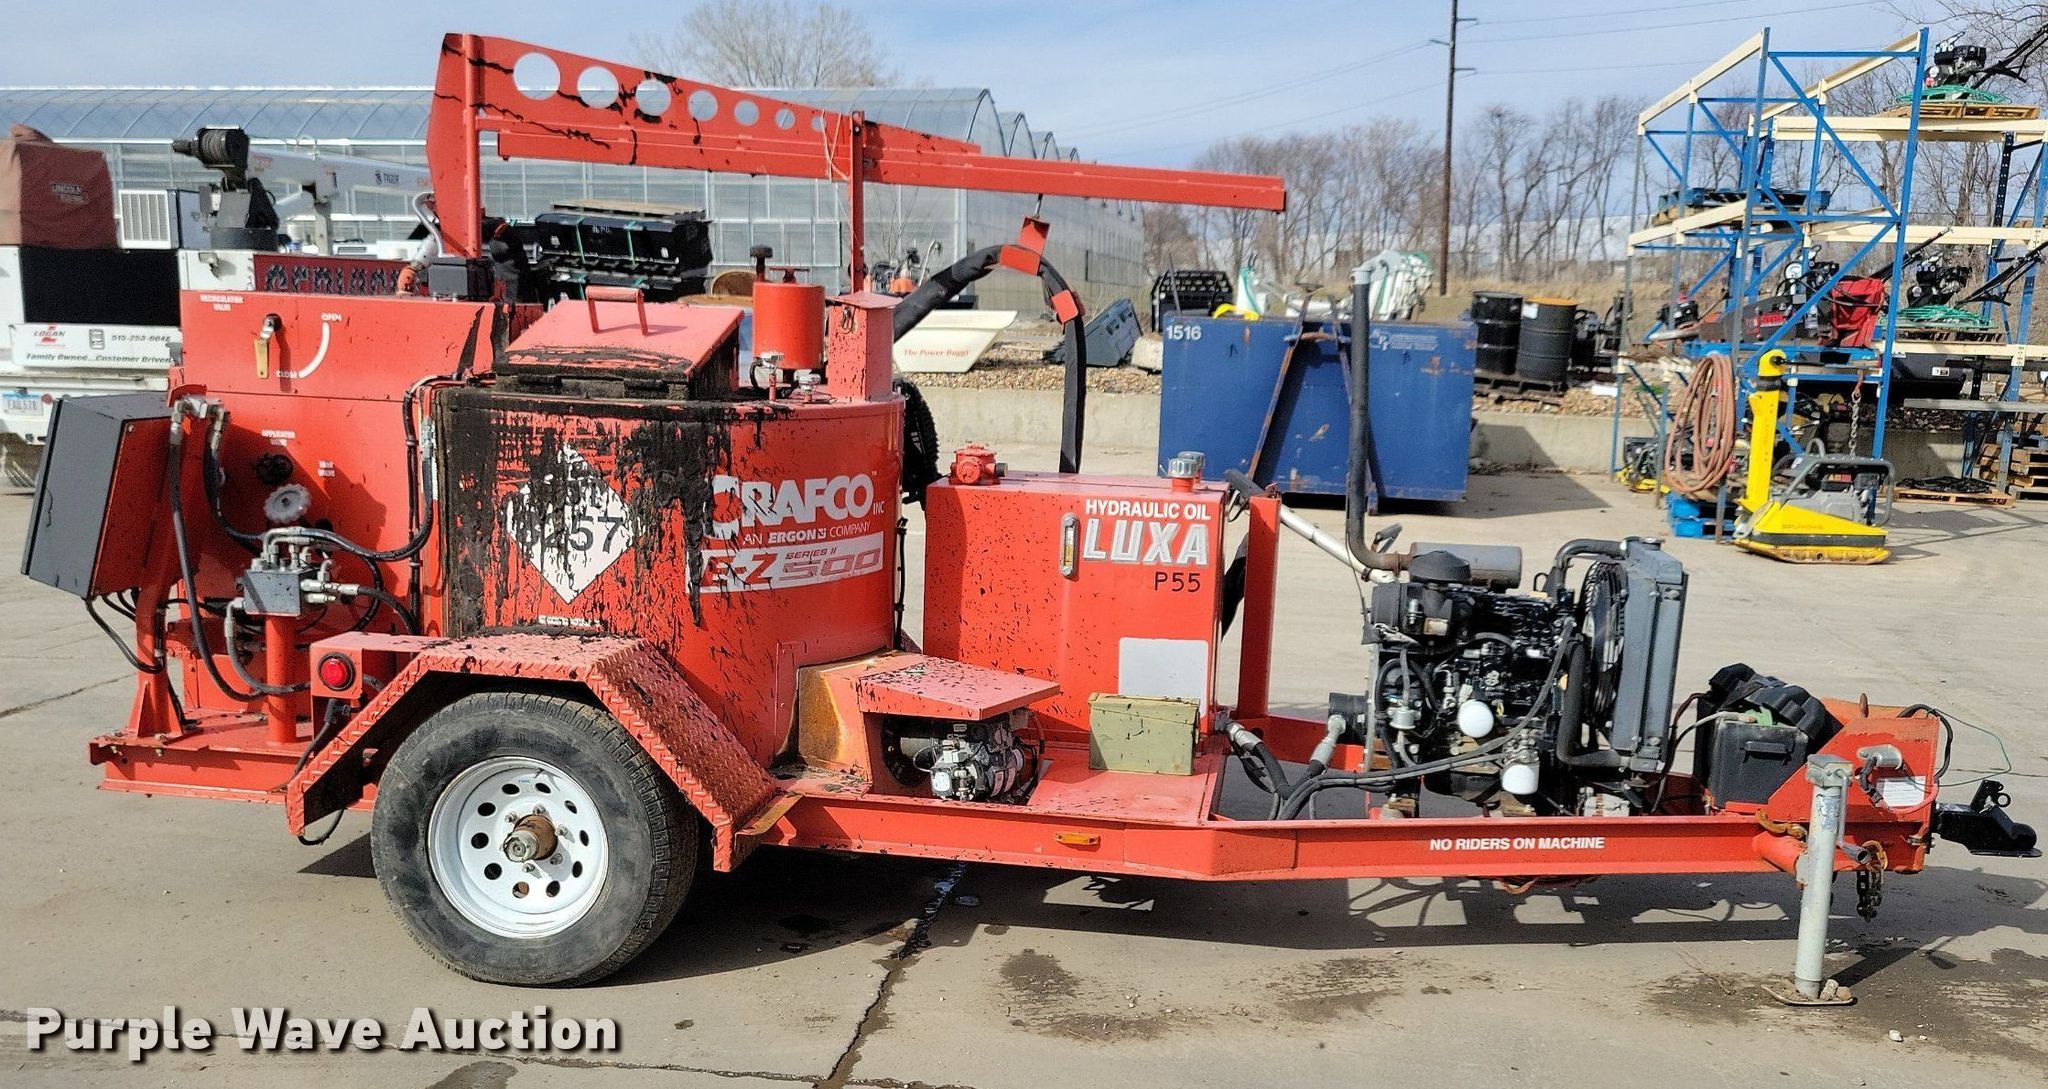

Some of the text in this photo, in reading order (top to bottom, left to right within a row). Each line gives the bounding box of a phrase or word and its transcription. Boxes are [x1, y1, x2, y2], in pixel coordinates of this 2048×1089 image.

[1166, 325, 1202, 340] 1516
[26, 353, 55, 361] Family
[873, 501, 885, 516] INC
[1085, 499, 1211, 521] HYDRAULIC OIL
[742, 521, 871, 546] AN ERGON COMPANY
[1082, 518, 1210, 567] LUXA
[784, 549, 828, 560] SERIES
[779, 548, 881, 582] 500
[1154, 571, 1201, 593] P55
[1430, 837, 1606, 850] NO RIDERS ON MACHINE
